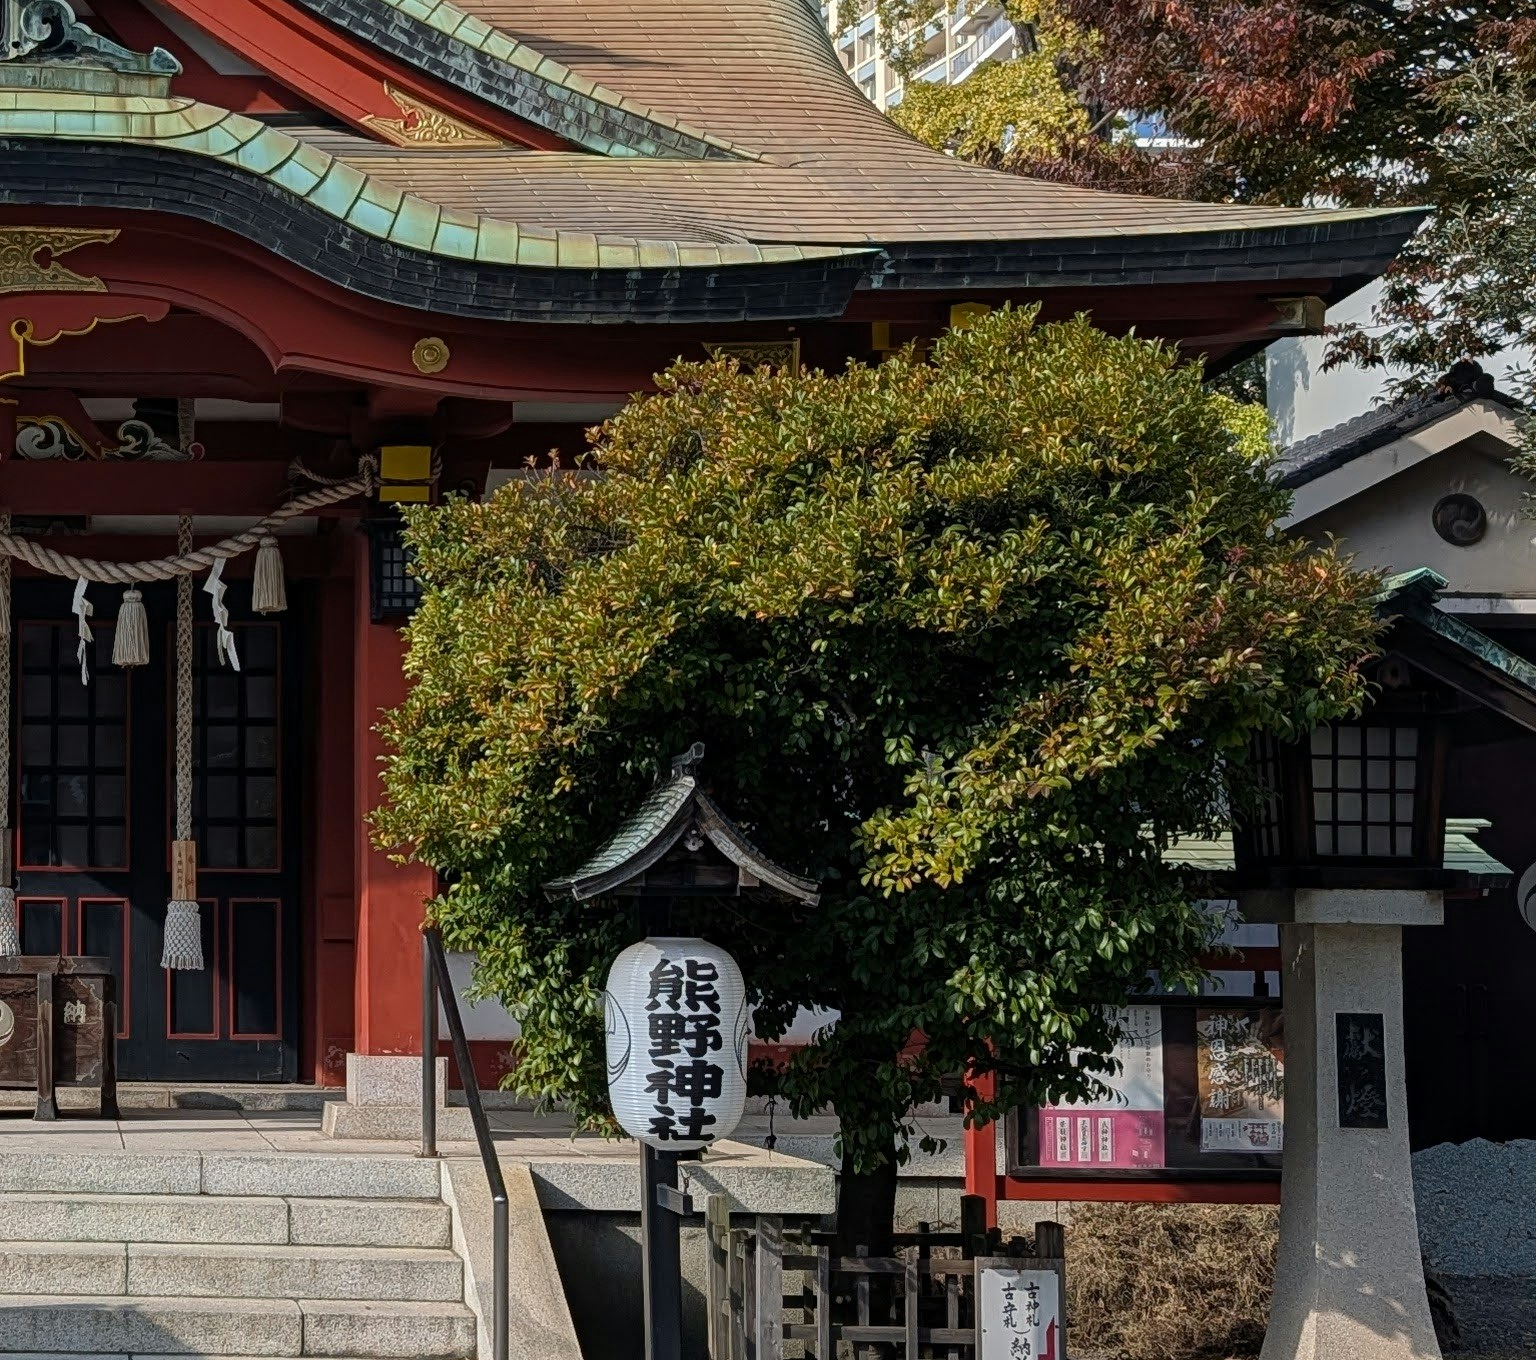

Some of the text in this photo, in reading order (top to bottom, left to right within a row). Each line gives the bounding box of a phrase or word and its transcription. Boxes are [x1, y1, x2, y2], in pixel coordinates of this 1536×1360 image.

[64, 999, 87, 1025] 納
[643, 958, 725, 1142] 熊野神社
[1205, 1014, 1231, 1110] 神恩感謝
[1024, 1281, 1040, 1327] 古神札
